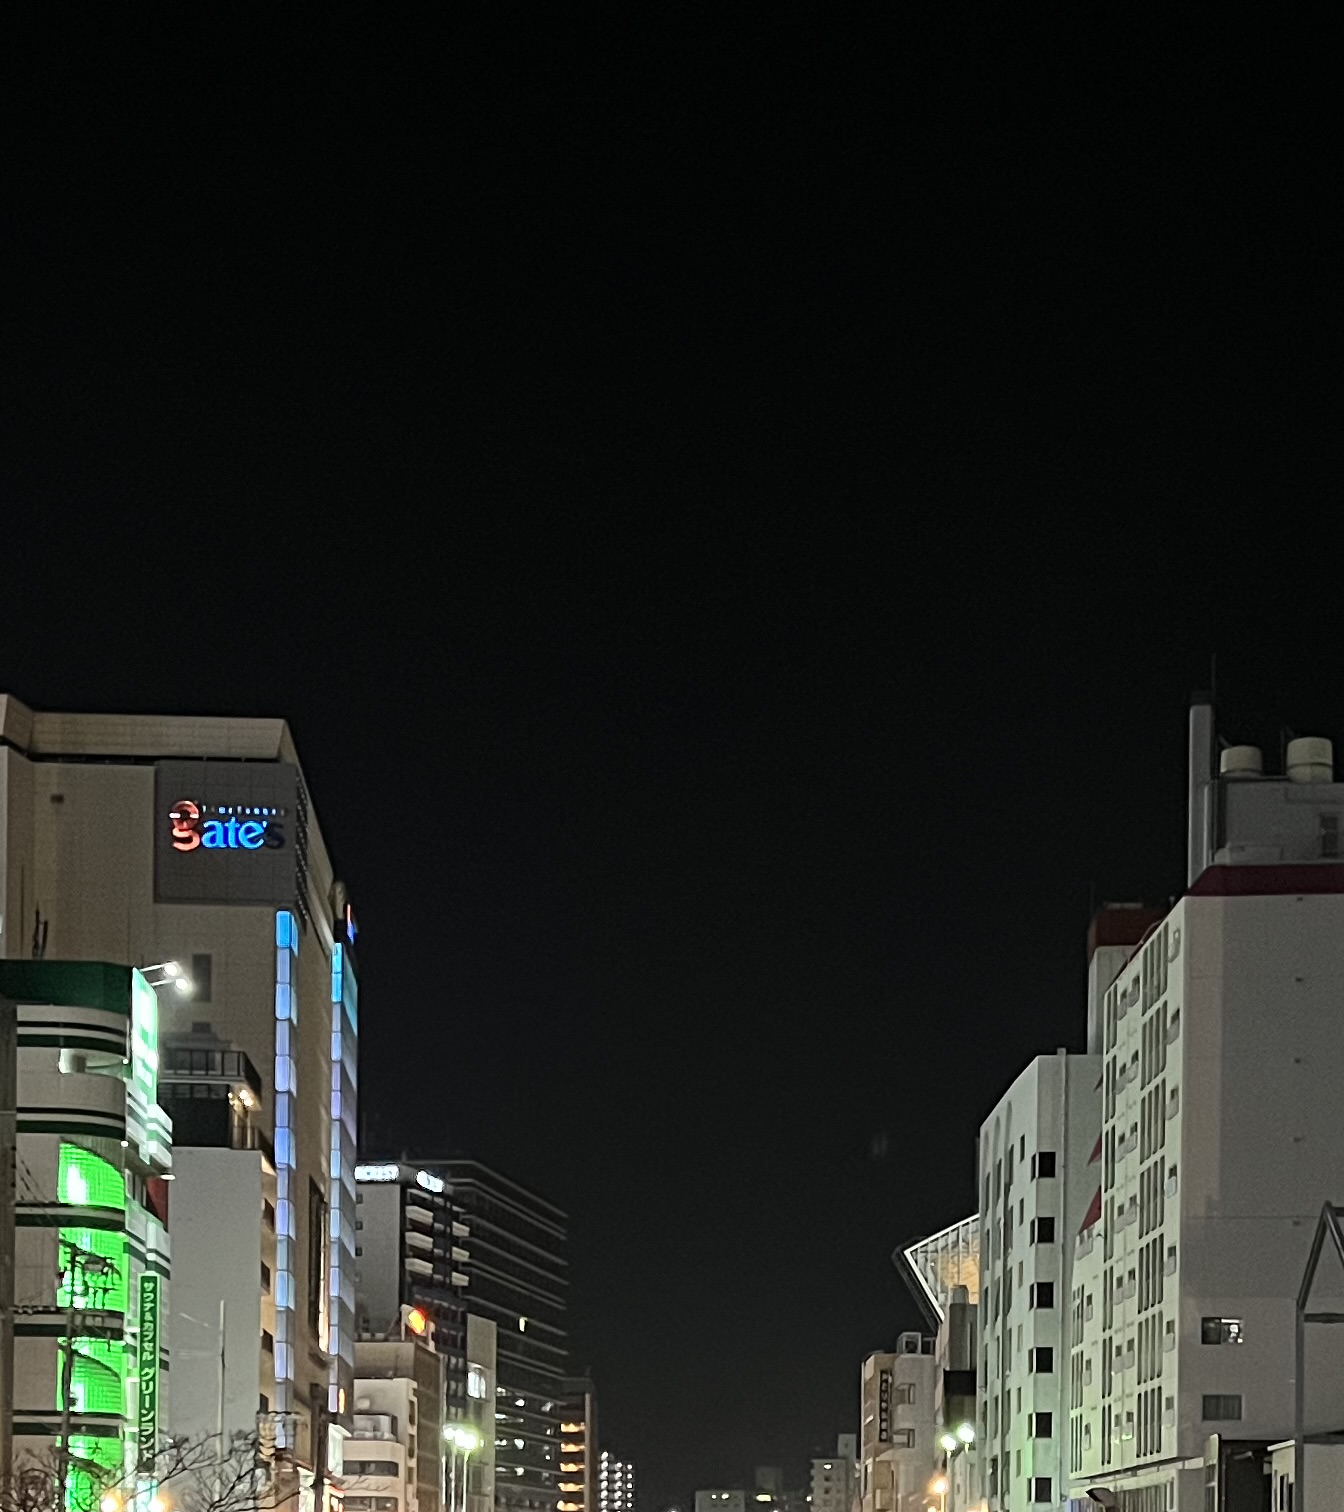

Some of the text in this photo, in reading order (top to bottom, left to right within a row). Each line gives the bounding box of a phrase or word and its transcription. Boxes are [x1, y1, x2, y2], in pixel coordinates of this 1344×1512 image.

[141, 1366, 155, 1462] グリーンランド
